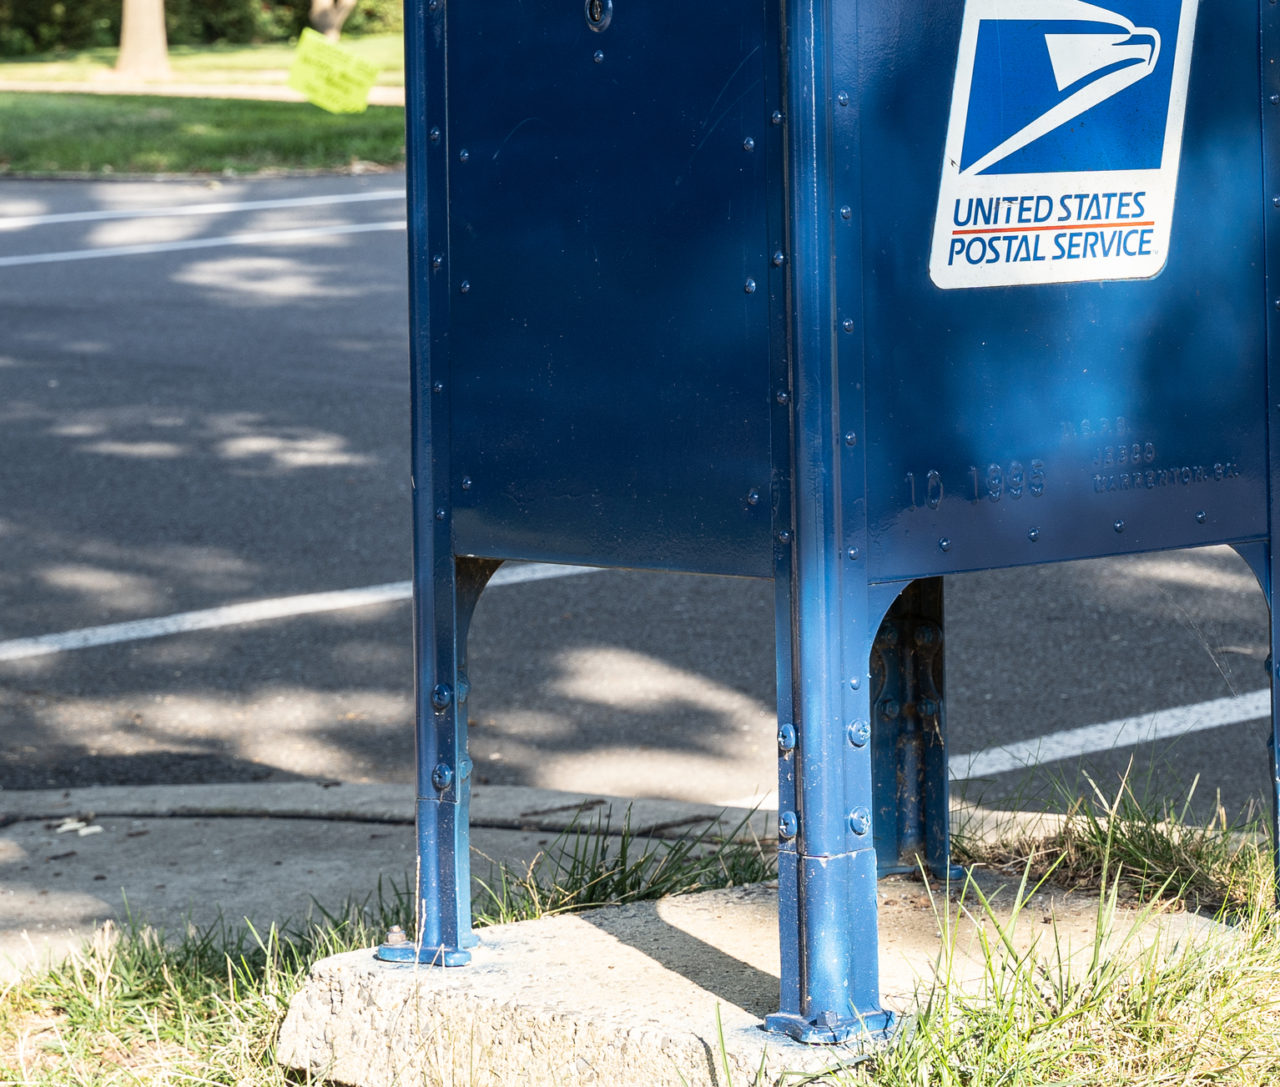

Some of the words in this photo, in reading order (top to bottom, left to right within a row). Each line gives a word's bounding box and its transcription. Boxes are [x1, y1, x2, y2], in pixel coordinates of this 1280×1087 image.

[953, 195, 1053, 226] UNITED
[1058, 192, 1146, 221] STATES
[948, 234, 1045, 265] POSTAL
[1052, 229, 1153, 260] SERVICE
[904, 470, 943, 510] 10
